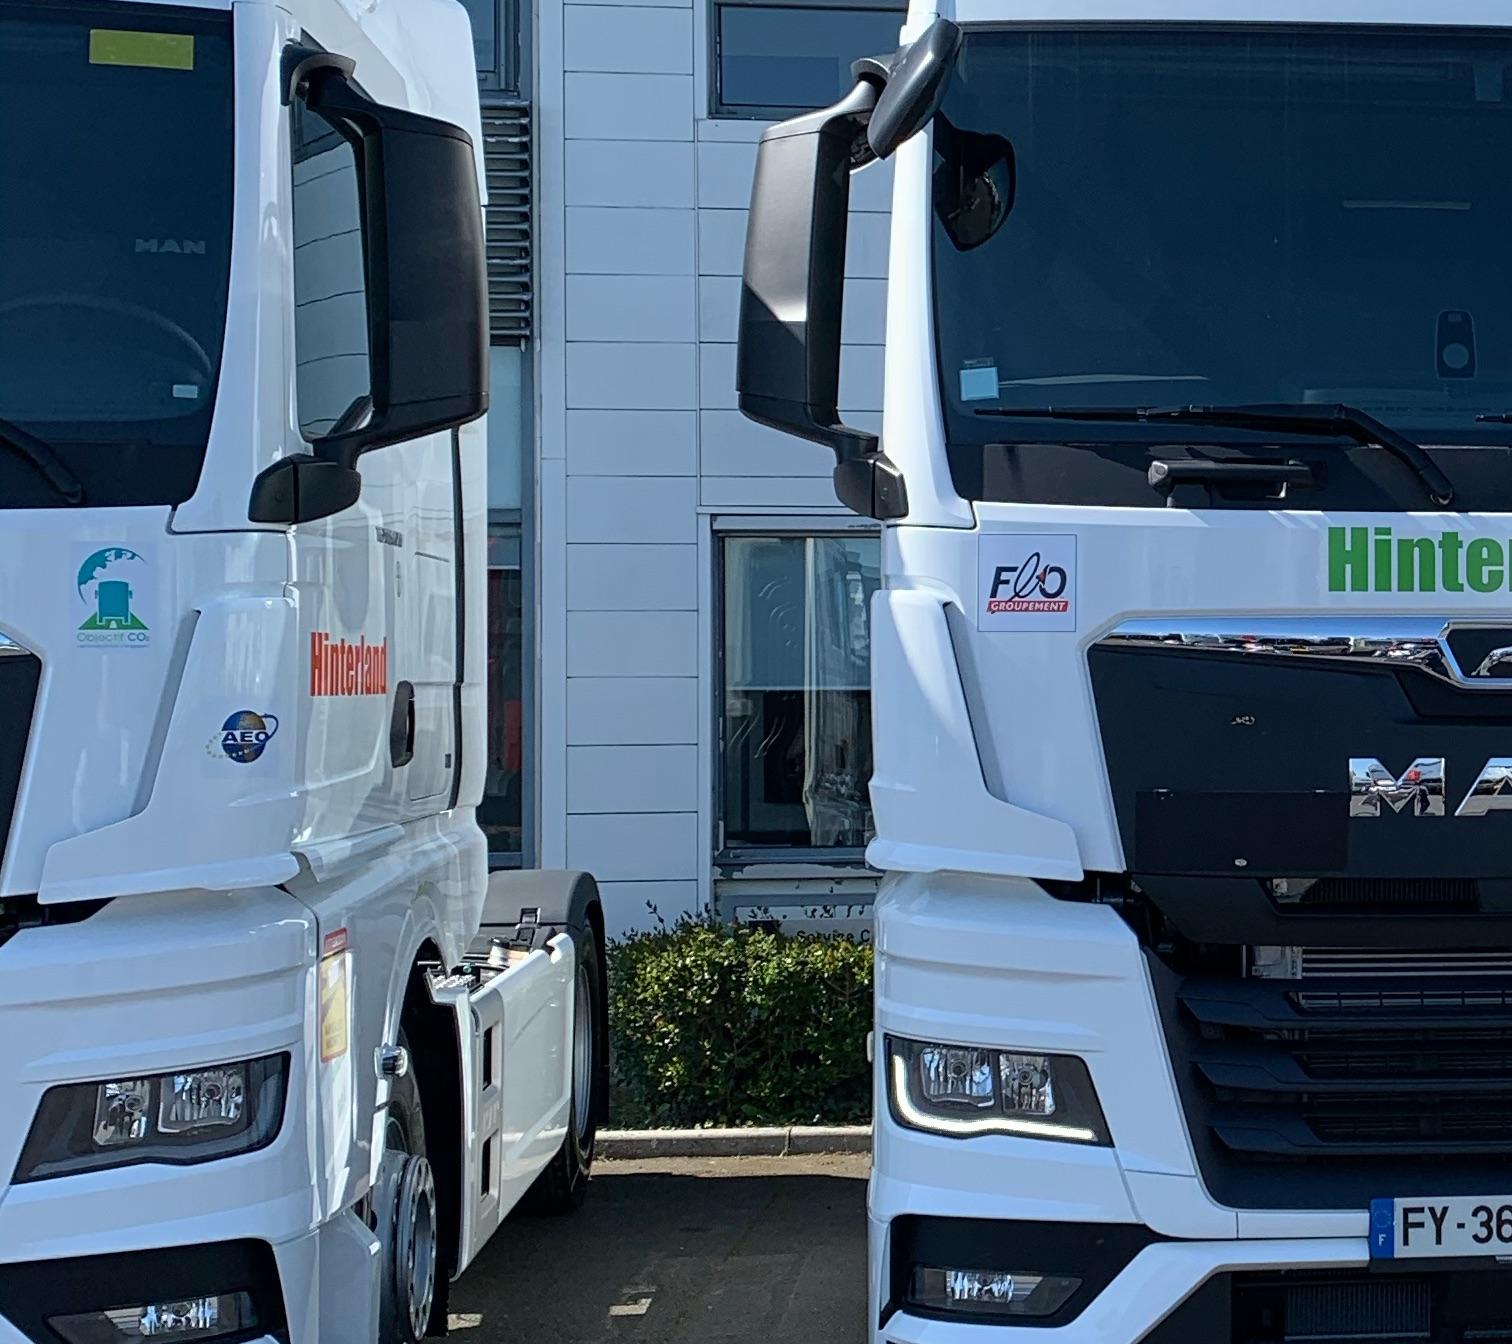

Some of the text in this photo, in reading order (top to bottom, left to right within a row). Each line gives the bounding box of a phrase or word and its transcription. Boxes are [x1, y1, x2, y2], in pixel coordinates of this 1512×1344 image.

[990, 601, 1066, 611] GROUPEMENT
[310, 631, 387, 696] Hinterland
[221, 731, 269, 743] AEO
[1378, 1234, 1387, 1247] F
